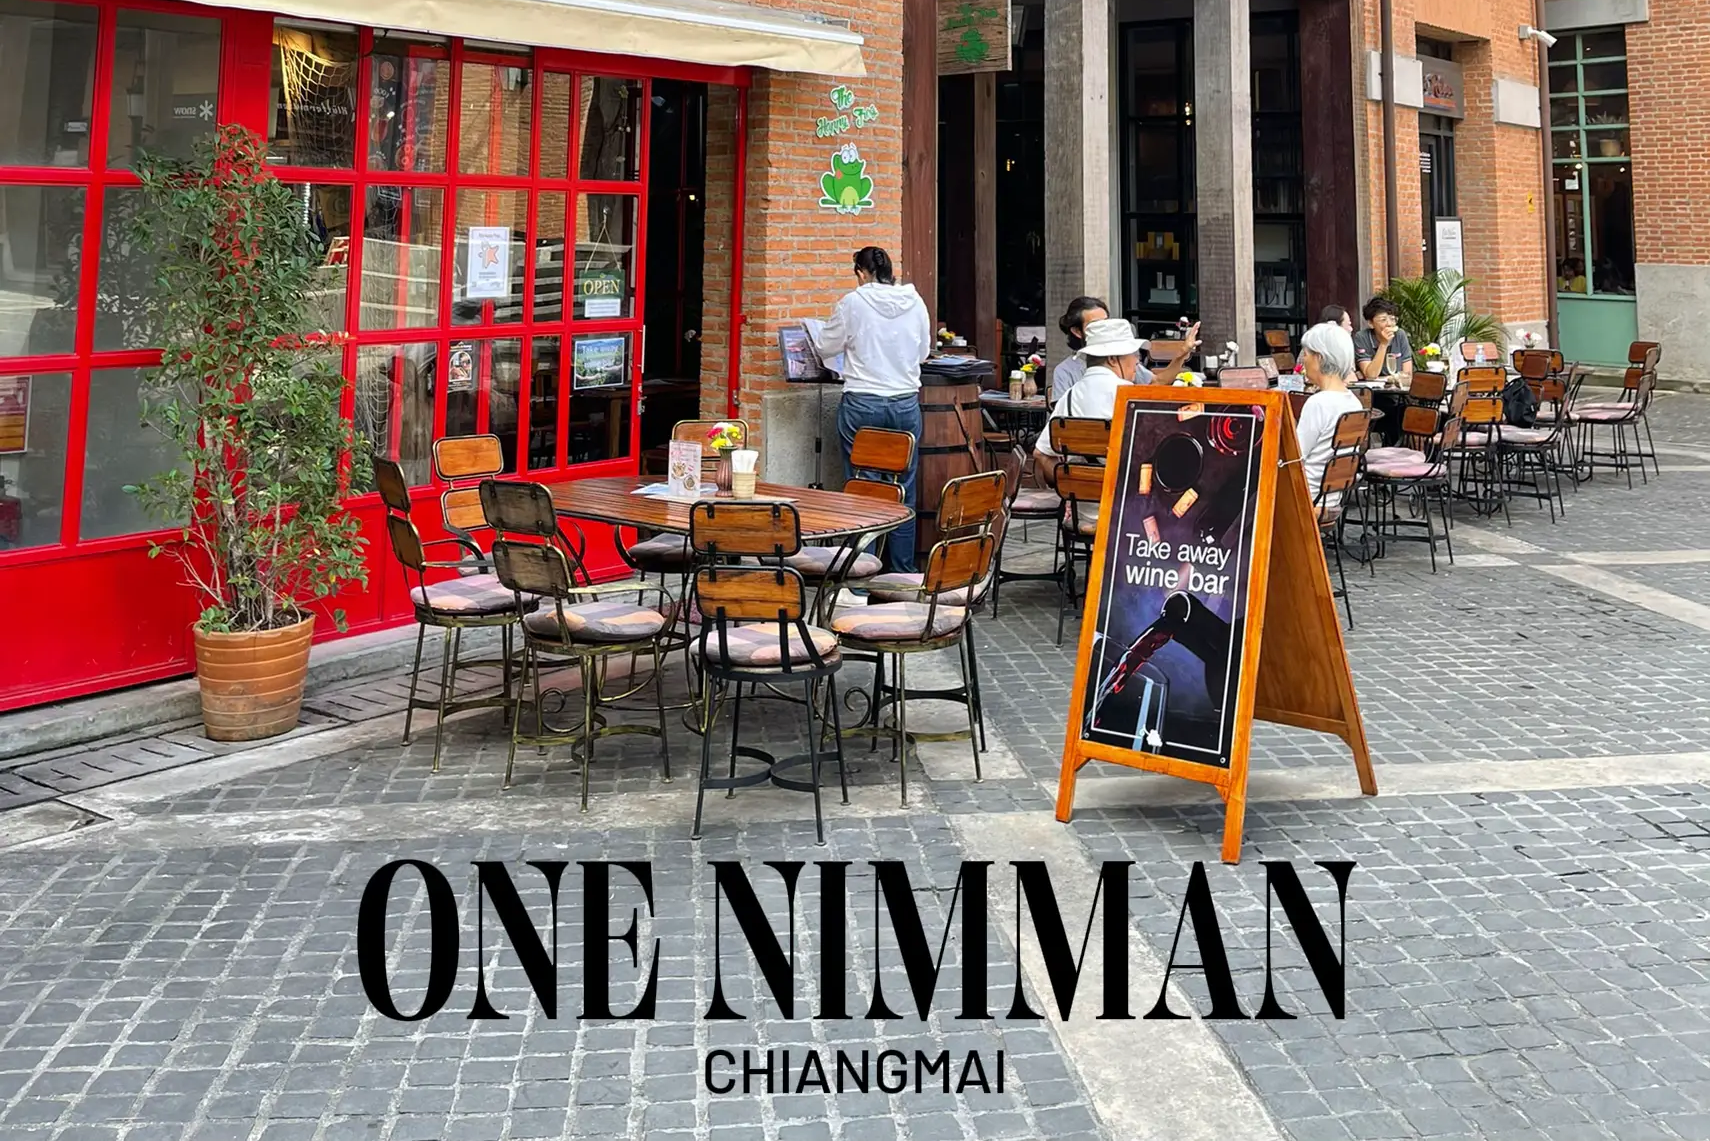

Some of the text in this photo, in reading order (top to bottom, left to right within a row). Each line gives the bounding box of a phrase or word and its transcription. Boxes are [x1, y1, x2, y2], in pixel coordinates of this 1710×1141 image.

[830, 85, 854, 110] The
[583, 279, 620, 295] OPEN
[1126, 533, 1231, 571] Take away
[1126, 561, 1229, 594] wine bar
